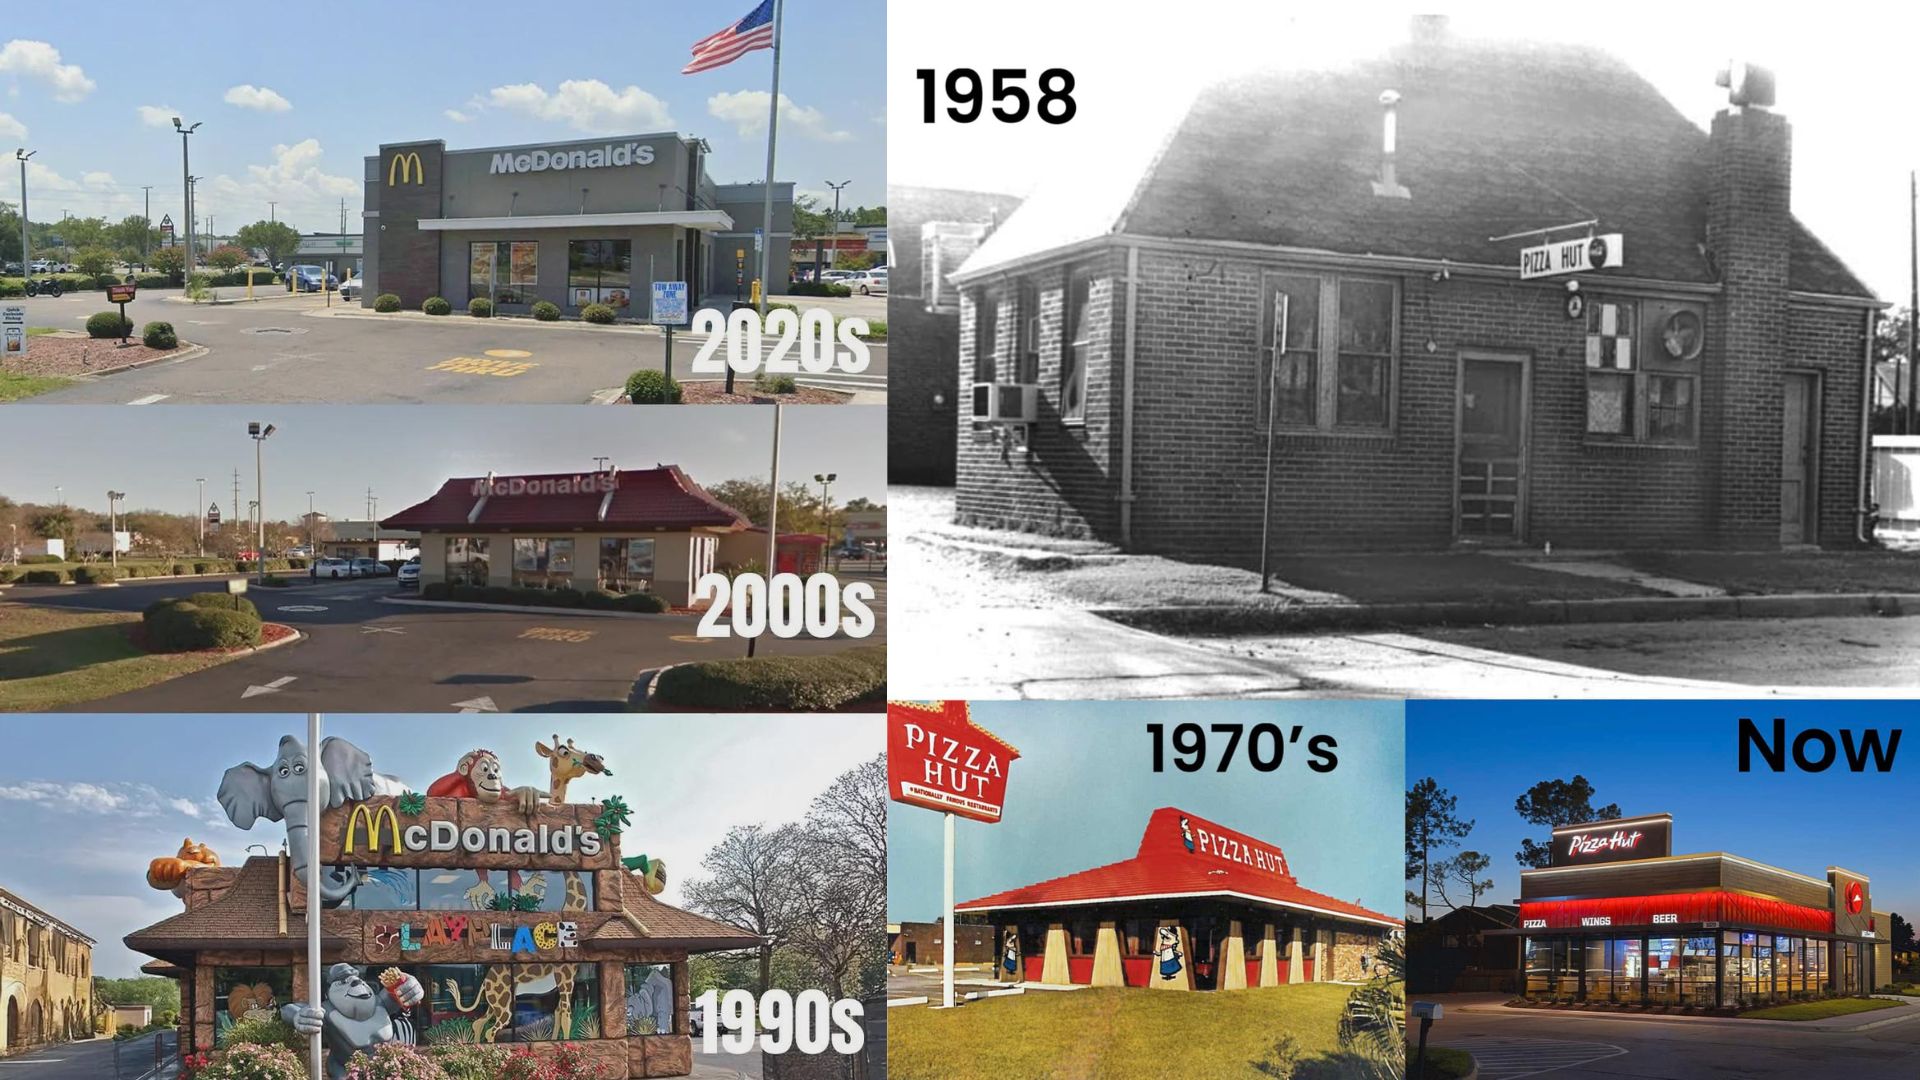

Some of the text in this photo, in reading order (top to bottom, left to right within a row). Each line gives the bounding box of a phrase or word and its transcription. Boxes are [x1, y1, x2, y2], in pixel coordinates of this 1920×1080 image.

[489, 143, 655, 174] McDonald's
[1523, 249, 1551, 274] PIZZA
[1561, 244, 1584, 269] HUT
[472, 474, 615, 496] McDonald's
[904, 723, 1001, 778] PIZZA
[924, 759, 990, 798] HUT
[345, 804, 601, 856] McDonald's
[1568, 831, 1643, 856] Pizza Hut
[1197, 828, 1284, 875] PIZZA HUT
[1523, 919, 1547, 928] PIZZA
[1582, 917, 1611, 926] WINGS
[1652, 913, 1678, 923] BEER
